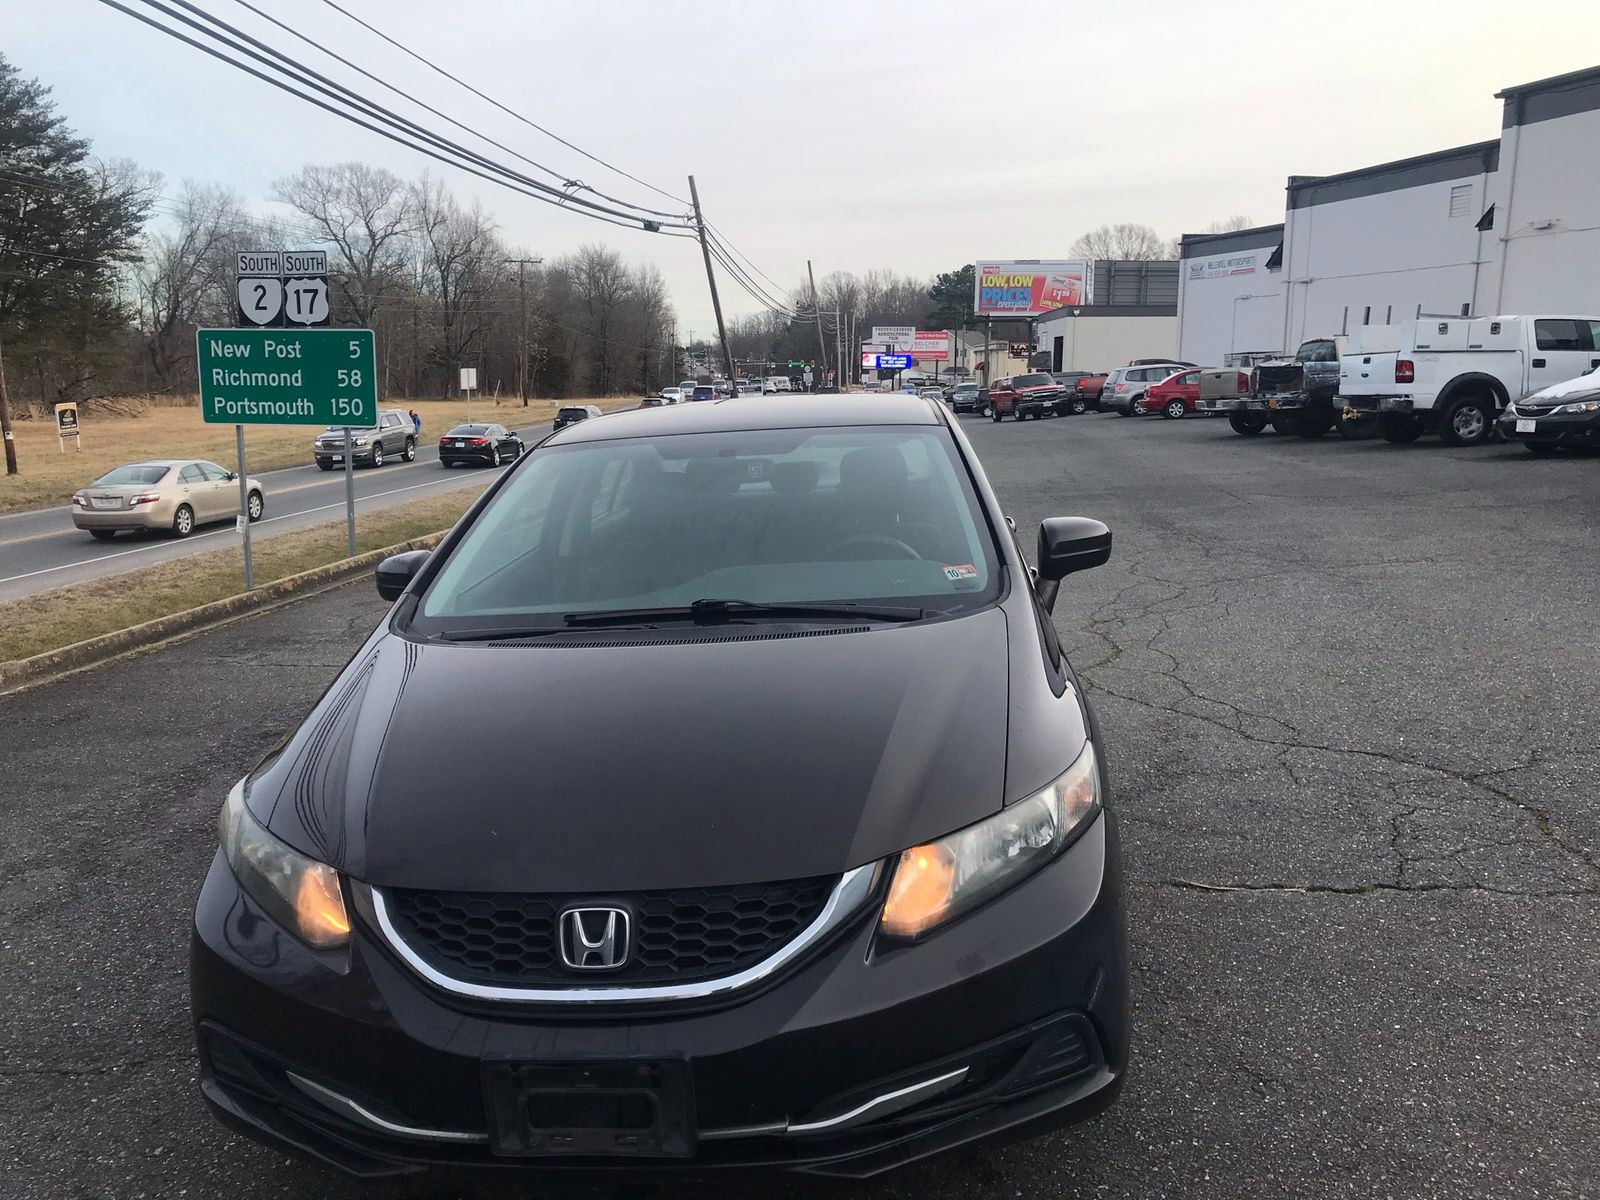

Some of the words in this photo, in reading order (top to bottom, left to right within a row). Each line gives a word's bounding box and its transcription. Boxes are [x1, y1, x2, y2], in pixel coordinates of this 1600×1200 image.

[240, 255, 278, 271] SOUTH
[286, 255, 324, 271] SOUTH
[1009, 274, 1034, 288] LOW
[253, 284, 268, 311] 2
[294, 288, 319, 315] 17
[982, 288, 1031, 305] PRICES
[210, 340, 250, 358] New
[264, 340, 302, 358] Post
[349, 341, 361, 359] 5
[212, 368, 302, 387] Richmond
[337, 369, 362, 388] 58
[214, 397, 314, 416] Portsmouth
[331, 398, 363, 416] 150
[947, 569, 959, 578] 10
